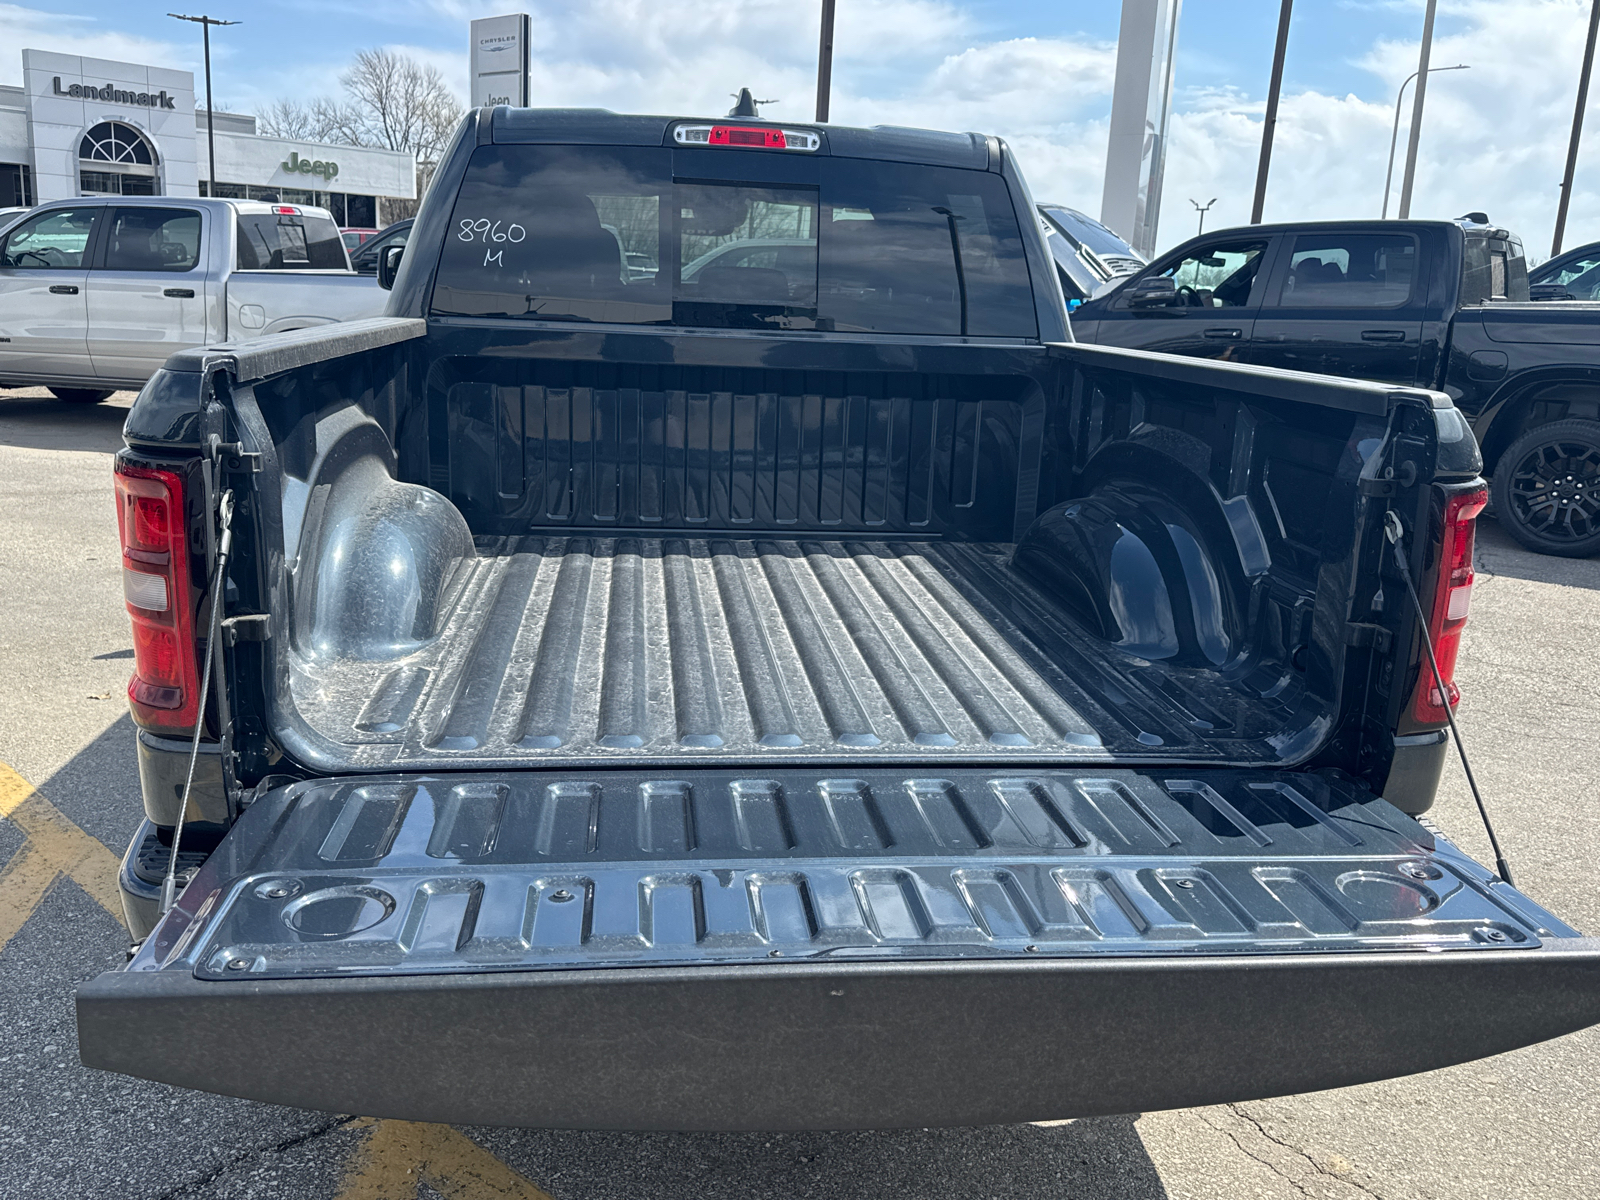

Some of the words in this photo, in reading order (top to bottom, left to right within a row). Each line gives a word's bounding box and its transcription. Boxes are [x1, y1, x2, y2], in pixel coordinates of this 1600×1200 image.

[480, 35, 516, 45] CHRYSLER
[53, 76, 176, 110] Landmark
[281, 151, 339, 181] Jeep
[457, 217, 526, 243] 8960
[483, 248, 504, 268] M
